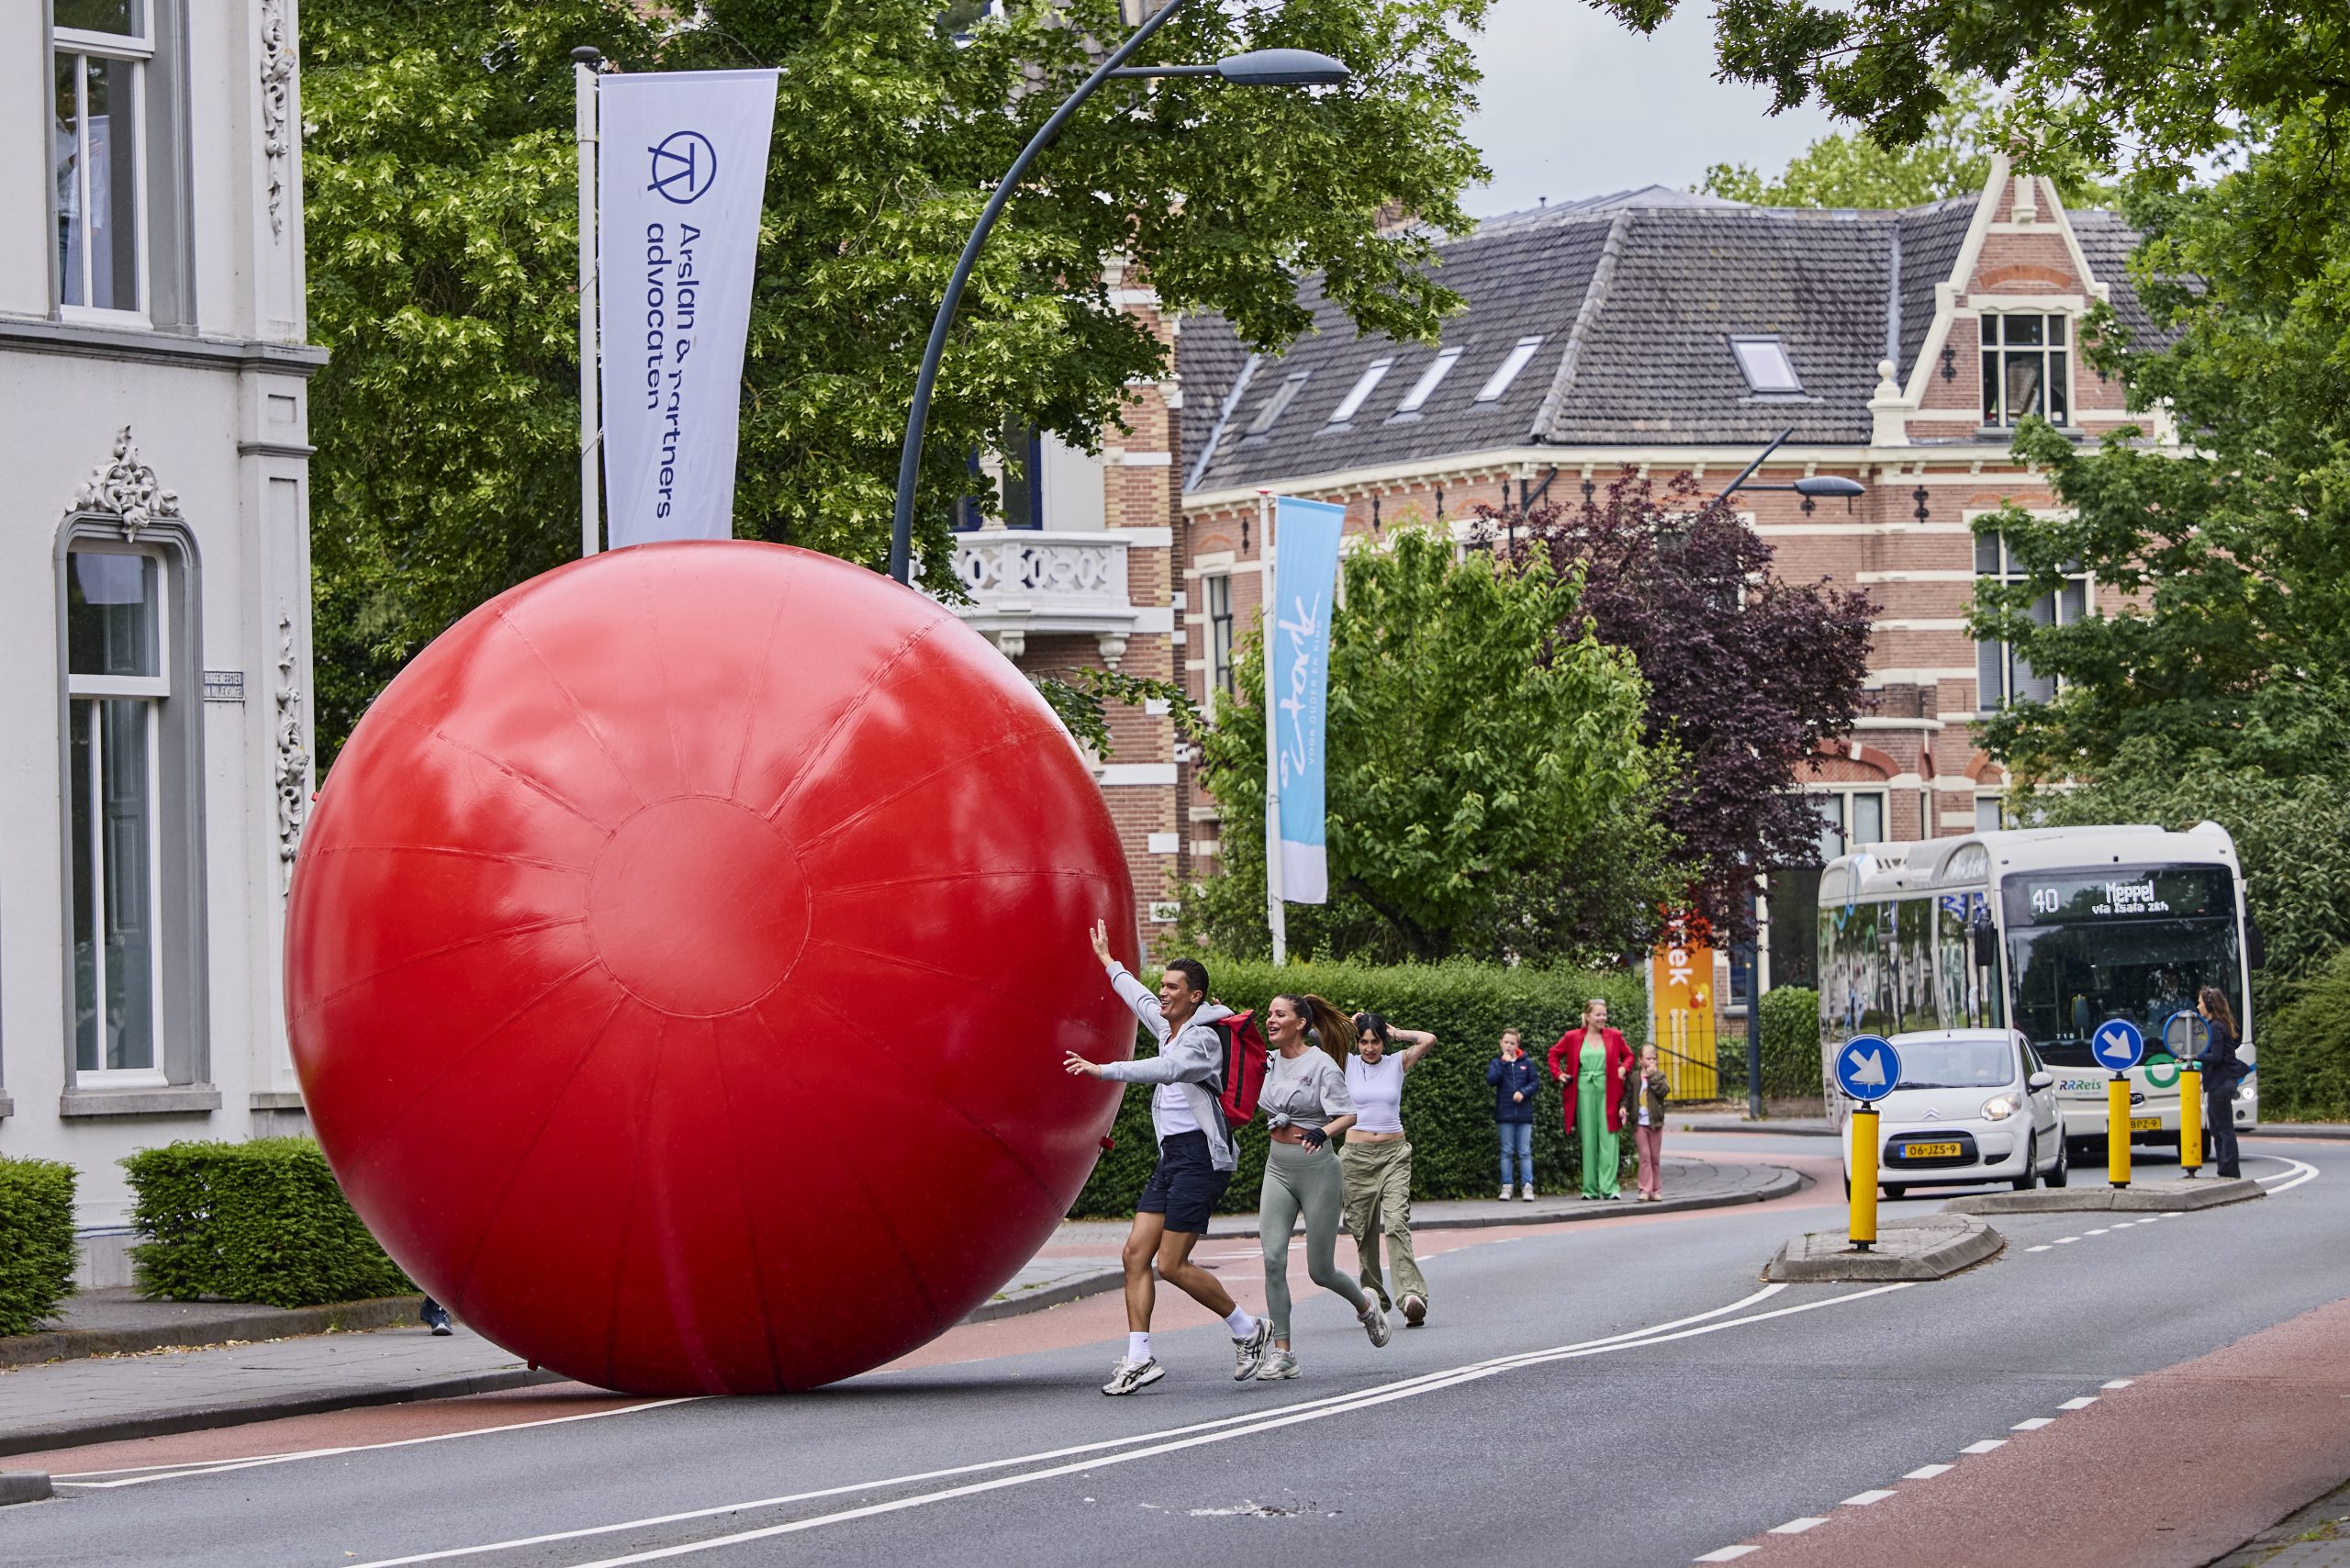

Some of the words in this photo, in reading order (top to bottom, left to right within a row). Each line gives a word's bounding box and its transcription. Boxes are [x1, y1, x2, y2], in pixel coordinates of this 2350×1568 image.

[677, 223, 700, 330] Arslan
[647, 223, 672, 410] advocaten
[677, 339, 690, 364] &
[1311, 657, 1320, 675] EN
[1309, 679, 1318, 724] OUDER
[2032, 888, 2059, 913] 40
[2105, 879, 2154, 903] Meppel
[2092, 903, 2111, 915] via
[2059, 1079, 2101, 1091] RRReis
[1909, 1144, 1956, 1156] 06-JZS-9
